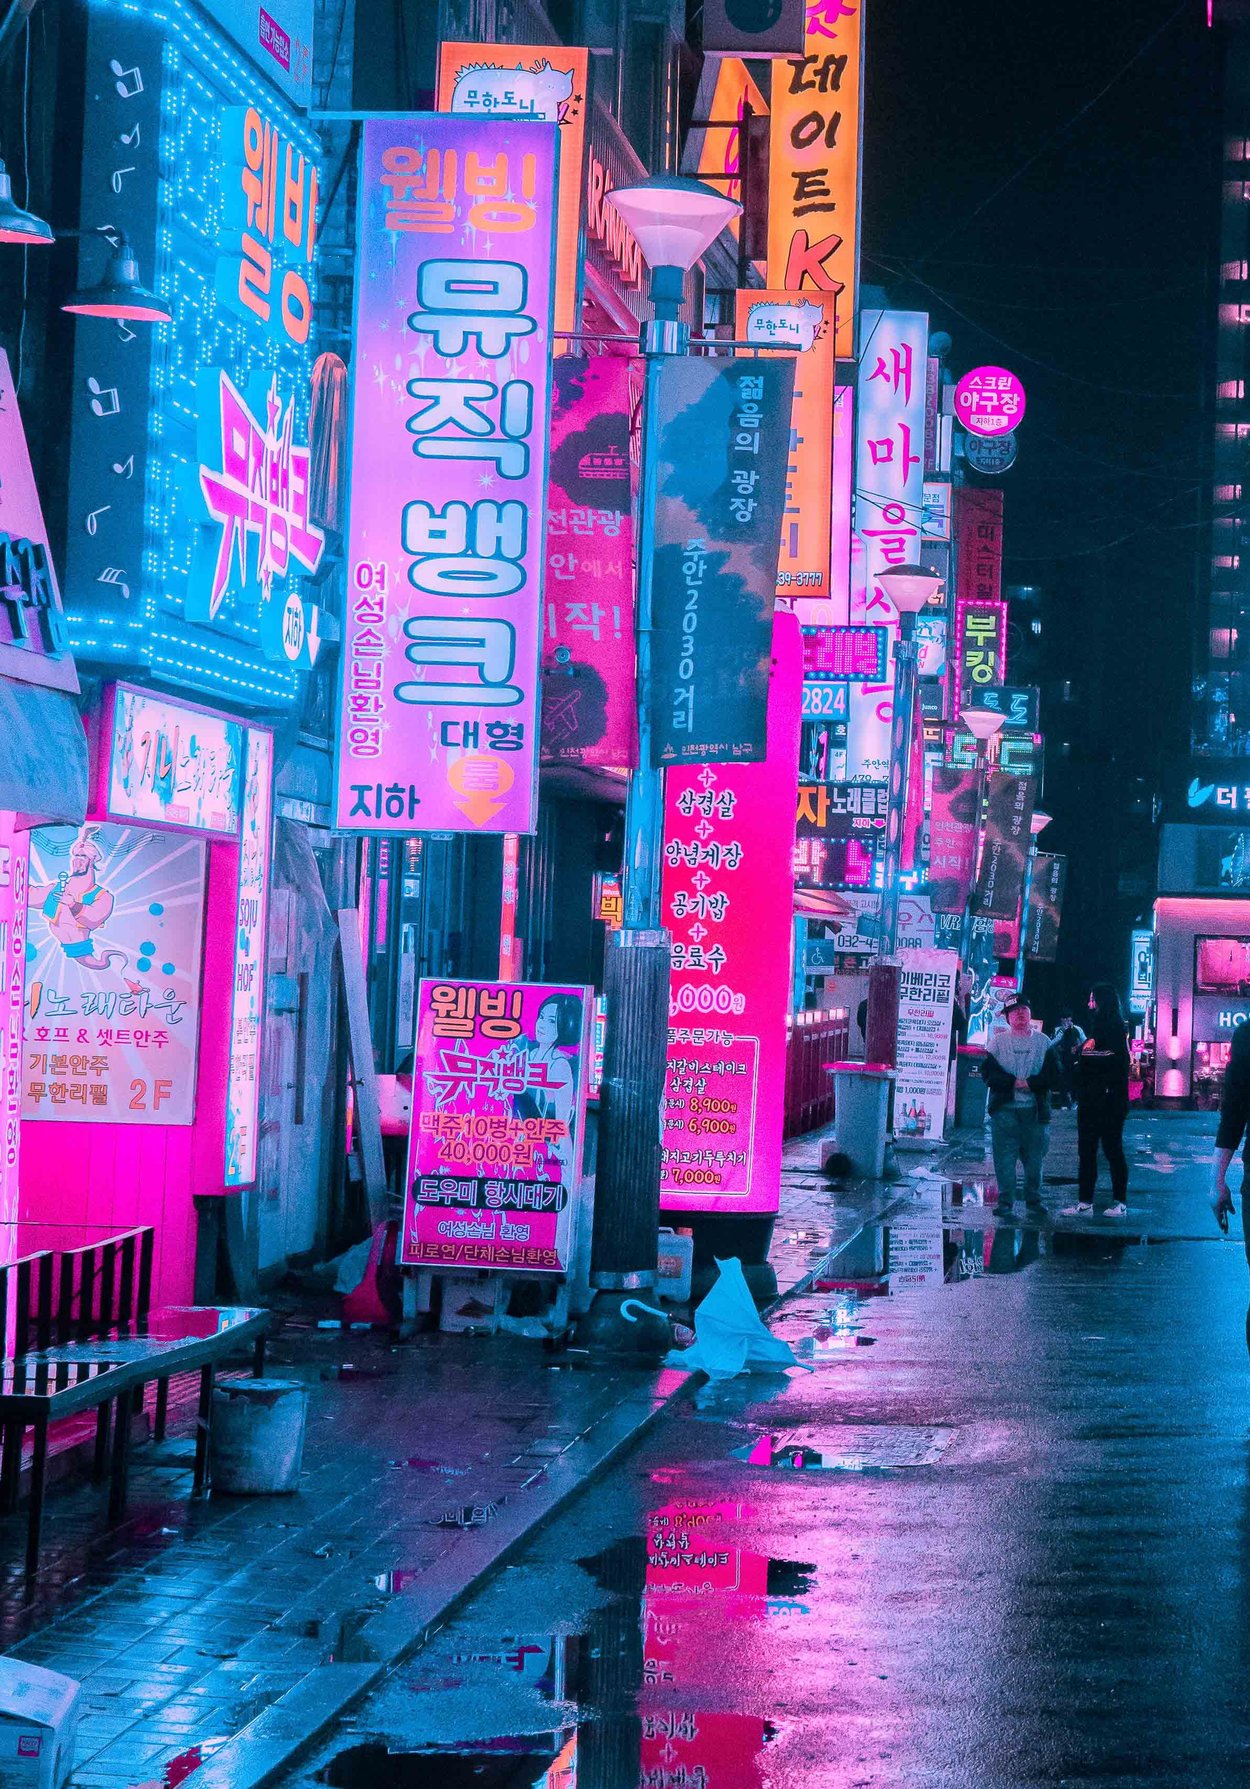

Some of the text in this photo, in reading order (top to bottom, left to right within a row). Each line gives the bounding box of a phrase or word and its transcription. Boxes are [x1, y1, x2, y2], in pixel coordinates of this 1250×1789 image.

[784, 54, 848, 217] 데이트
[380, 146, 536, 234] 웰빙
[239, 107, 319, 345] 웰빙
[785, 229, 845, 293] K
[753, 318, 800, 335] 무한도니
[968, 376, 1013, 390] 스크린
[960, 391, 1020, 415] 야구장
[730, 375, 764, 523] 젊음의 광장
[394, 258, 537, 707] 뮤직뱅크
[347, 560, 389, 760] 여성손님환영
[965, 614, 997, 684] 부킹
[440, 720, 524, 752] 대형
[350, 782, 420, 820] 지하
[676, 789, 737, 819] 삼겹살
[665, 840, 744, 869] 양념게장
[238, 898, 258, 931] SOJU
[670, 892, 730, 921] 공기밥
[671, 943, 728, 974] 음료수
[236, 962, 254, 993] HOF
[430, 984, 524, 1040] 웰빙
[669, 982, 747, 1016] ,000원
[35, 1026, 170, 1049] 호프 & 셋트안주
[29, 1053, 110, 1077] 기본안주
[422, 1049, 568, 1104] 뮤직뱅크
[27, 1082, 109, 1106] 무한리필
[129, 1079, 173, 1111] 2F
[669, 1077, 708, 1095] 삼겹살
[438, 1140, 535, 1166] 40,000원
[417, 1178, 564, 1210] 도우미 항시대기
[437, 1220, 531, 1242] 여성손님 환영
[408, 1242, 559, 1266] 피로연/단체손님환영
